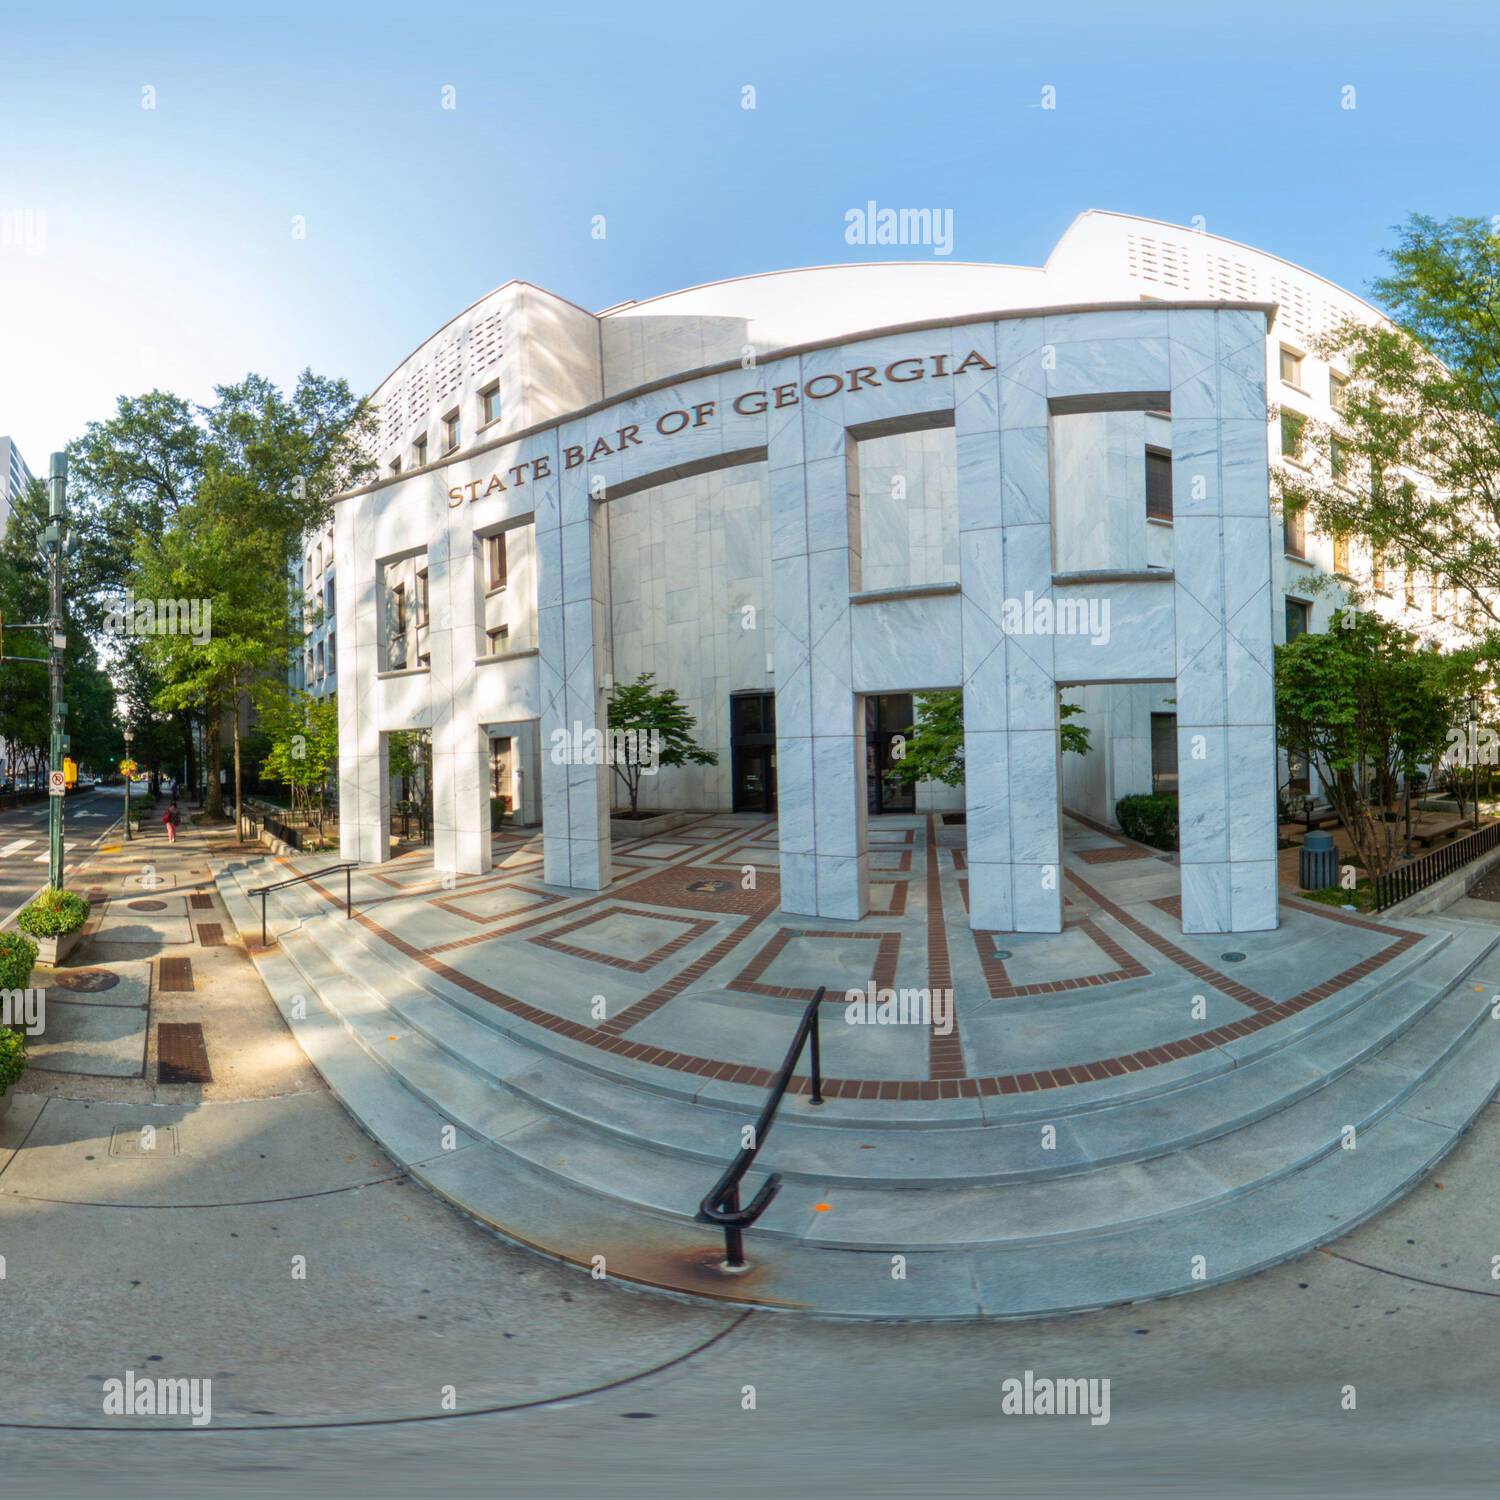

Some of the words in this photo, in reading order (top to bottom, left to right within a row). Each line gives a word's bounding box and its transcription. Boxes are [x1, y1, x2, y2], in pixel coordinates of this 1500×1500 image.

[448, 455, 551, 508] STATE
[563, 424, 643, 470] BAR
[656, 401, 718, 436] OF
[732, 350, 996, 415] GEORGIA
